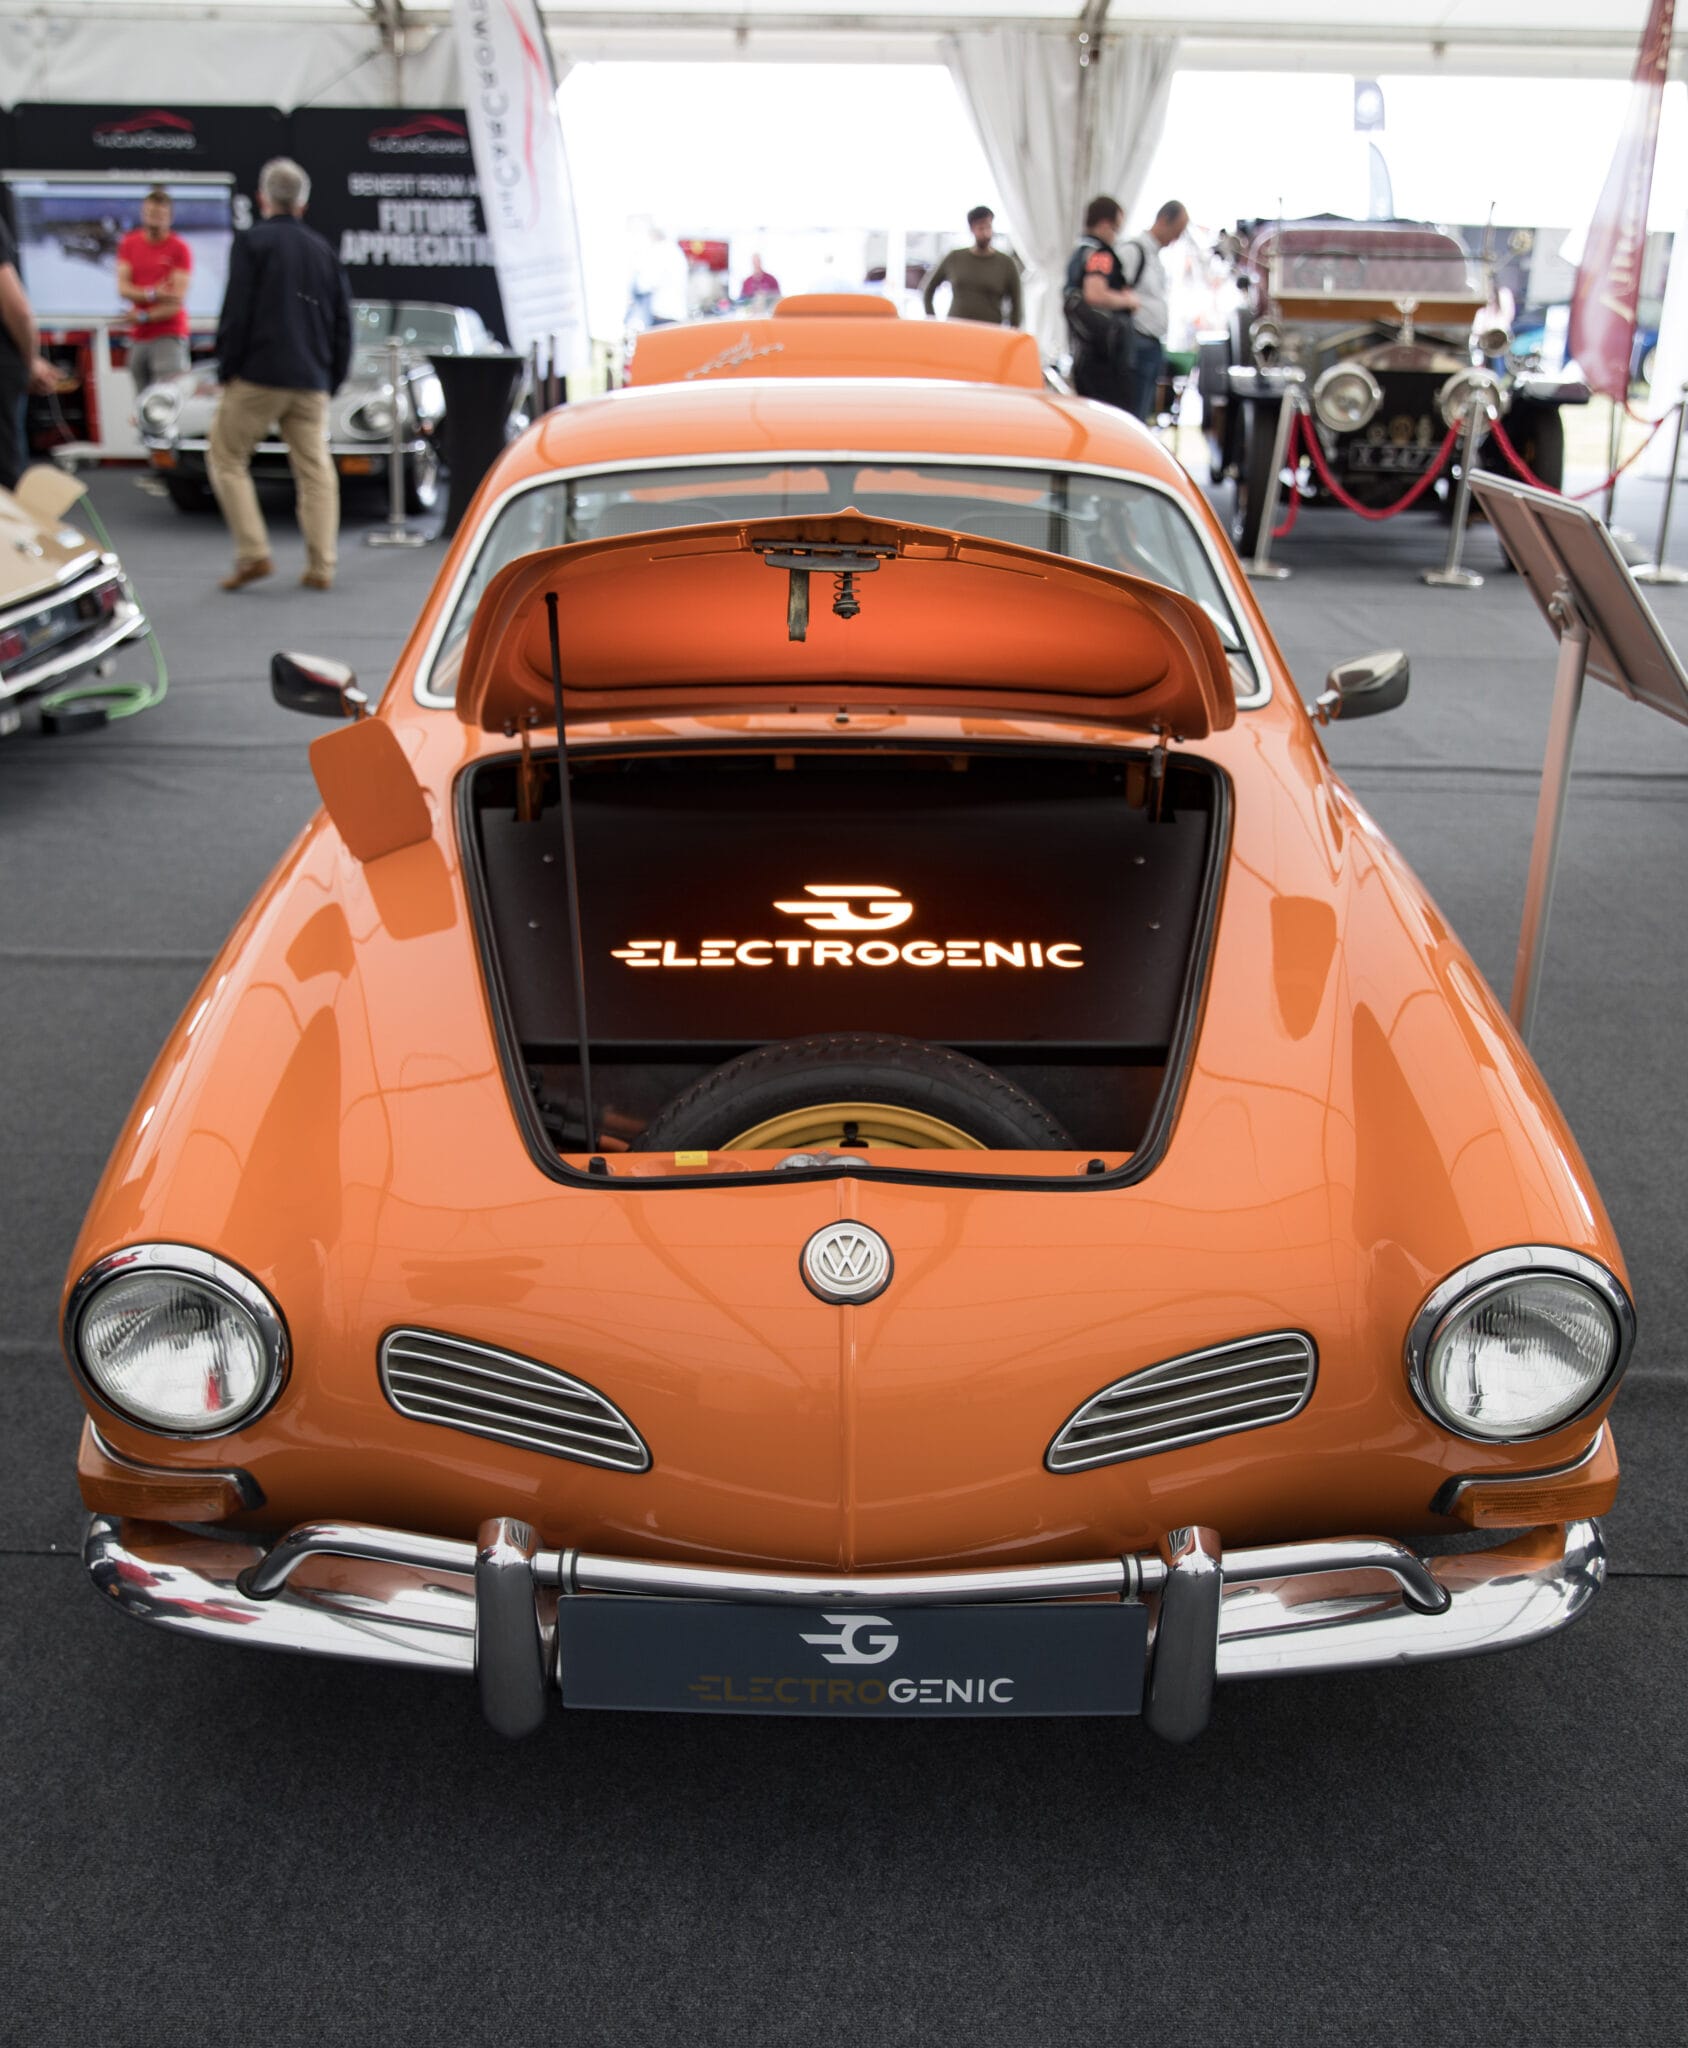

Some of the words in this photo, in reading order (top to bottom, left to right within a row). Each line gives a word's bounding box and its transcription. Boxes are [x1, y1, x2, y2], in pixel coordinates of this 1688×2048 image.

[347, 173, 415, 197] BENEFIT
[416, 173, 465, 198] FROM
[377, 199, 477, 234] FUTURE
[611, 939, 1085, 969] ELECTROGENIC
[688, 1676, 1015, 1704] ELECTROGENIC
